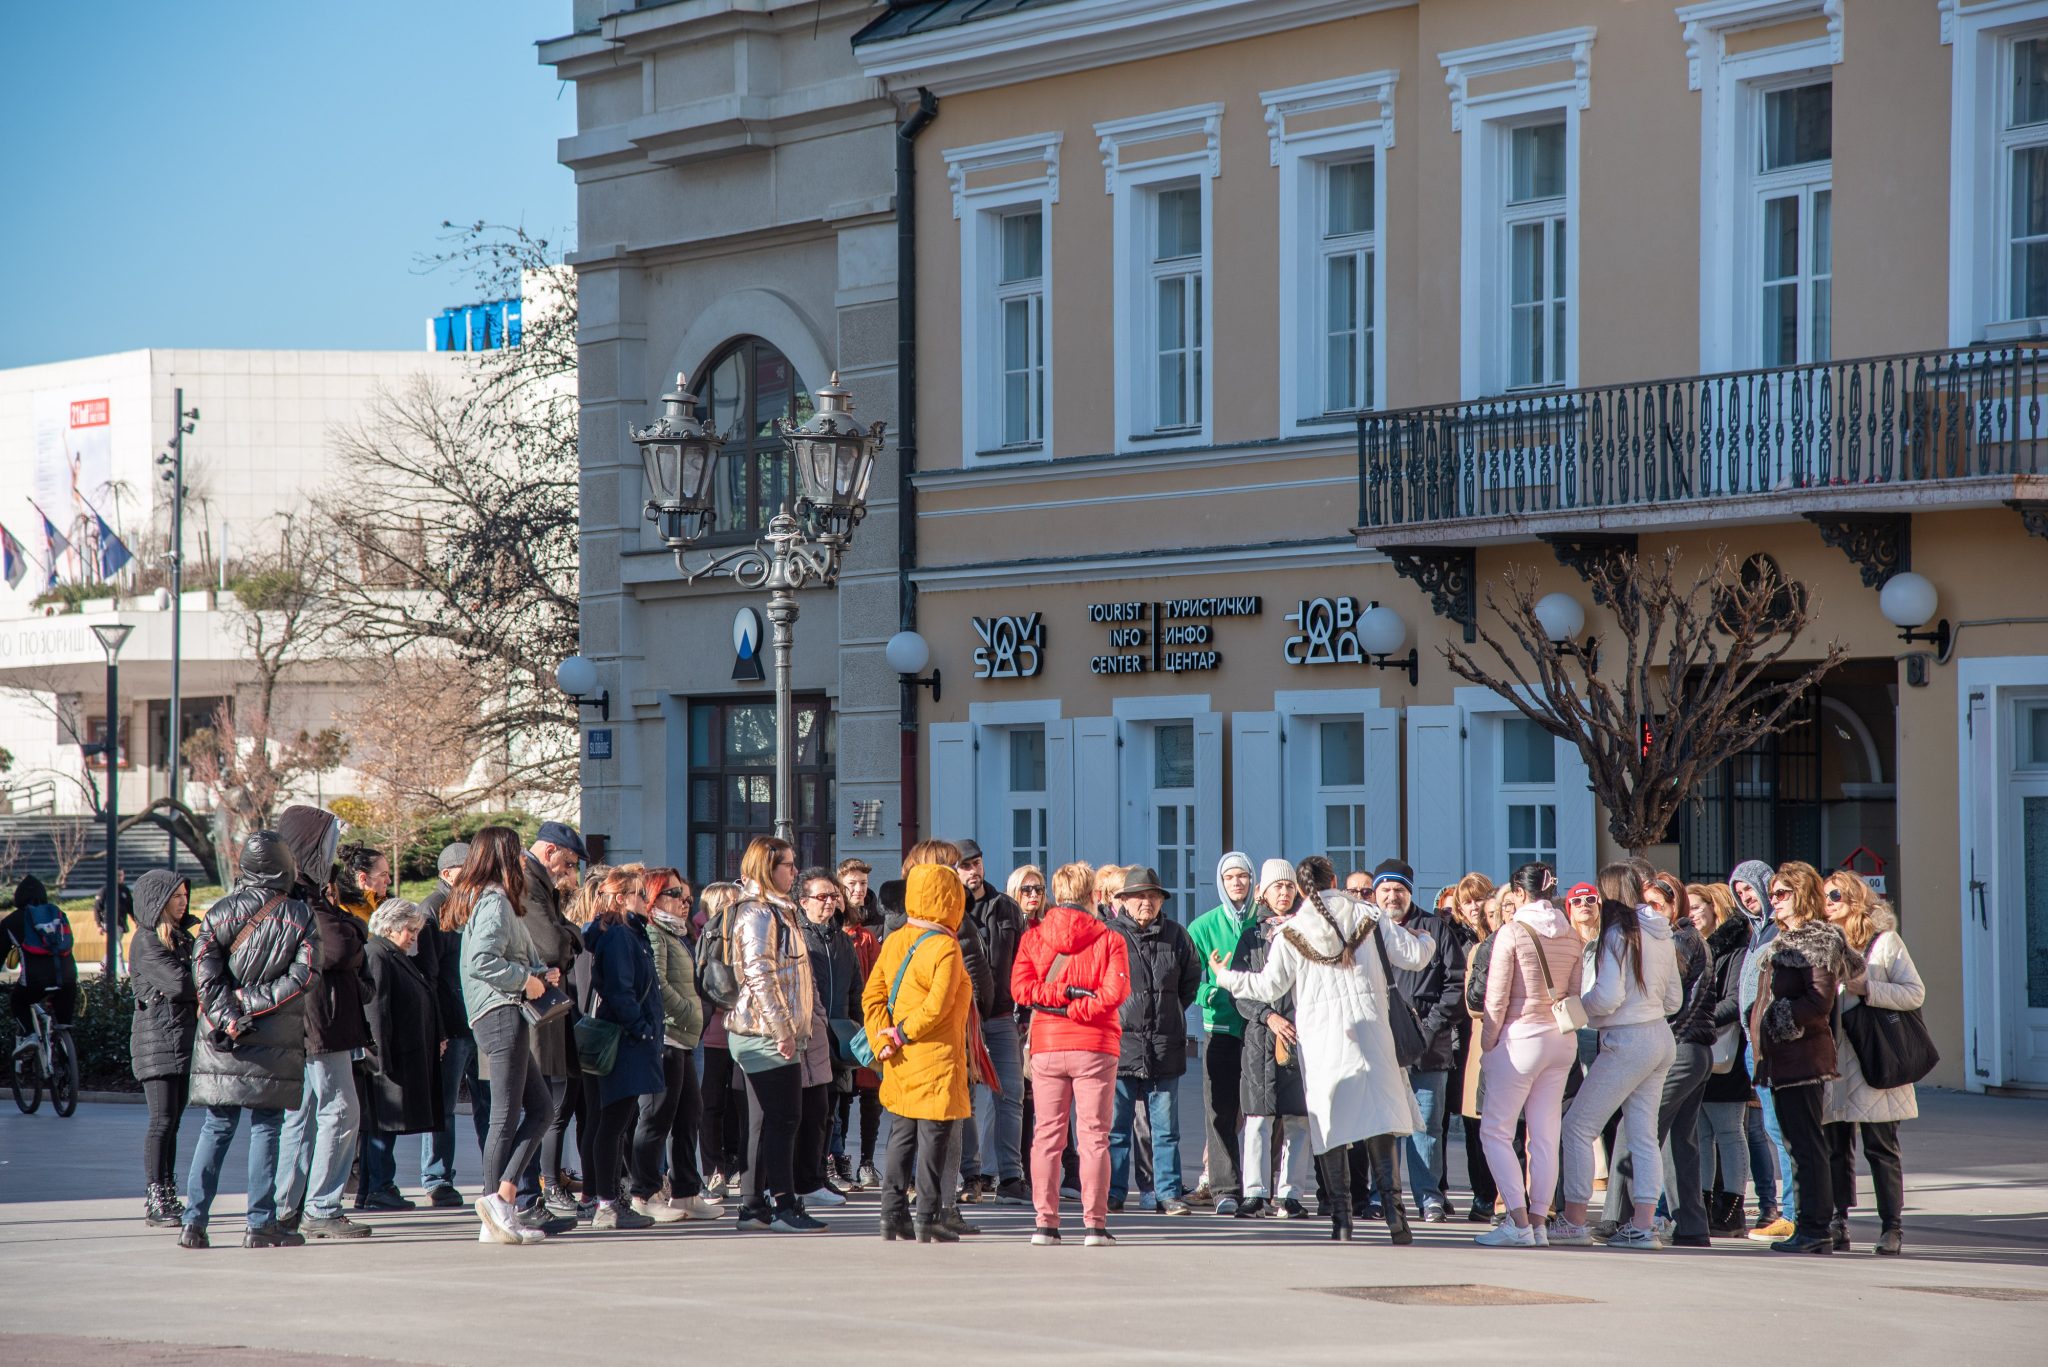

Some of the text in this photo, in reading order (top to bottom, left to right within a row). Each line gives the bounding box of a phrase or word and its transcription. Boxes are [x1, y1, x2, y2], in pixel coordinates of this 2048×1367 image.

[1087, 602, 1141, 622] TOURIST
[1165, 596, 1256, 618] ТУРИСТИЧКИ
[1283, 597, 1373, 643] НОВ
[1109, 628, 1141, 647] INFO
[1165, 625, 1207, 645] ИНФО
[1090, 655, 1141, 673] CENTER
[1165, 651, 1216, 674] ЦЕНТАР
